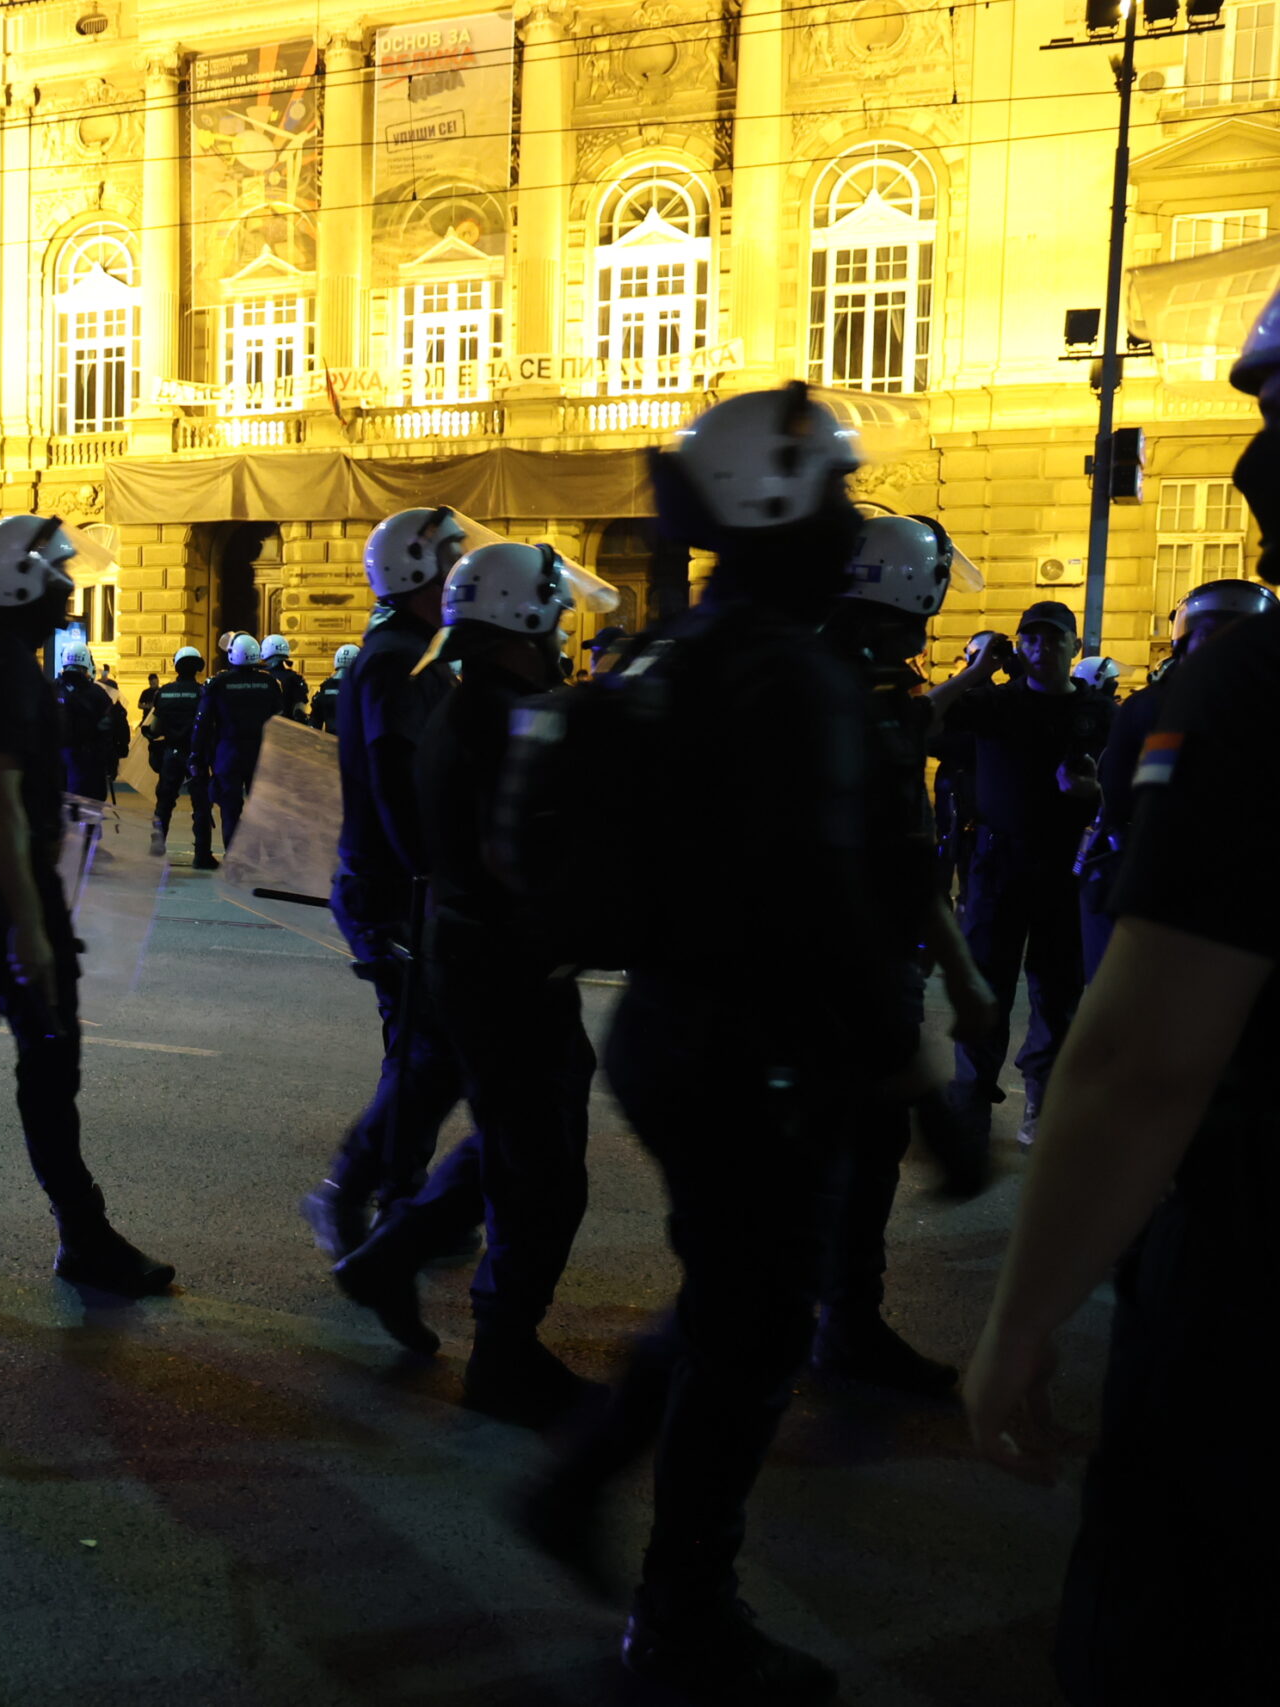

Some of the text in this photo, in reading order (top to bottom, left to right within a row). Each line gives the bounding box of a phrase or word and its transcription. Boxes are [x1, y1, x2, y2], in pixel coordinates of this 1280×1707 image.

[380, 28, 471, 53] ОСНОВ ЗА
[393, 120, 457, 146] УПИШИ СЕ!
[519, 358, 552, 380] СЕ
